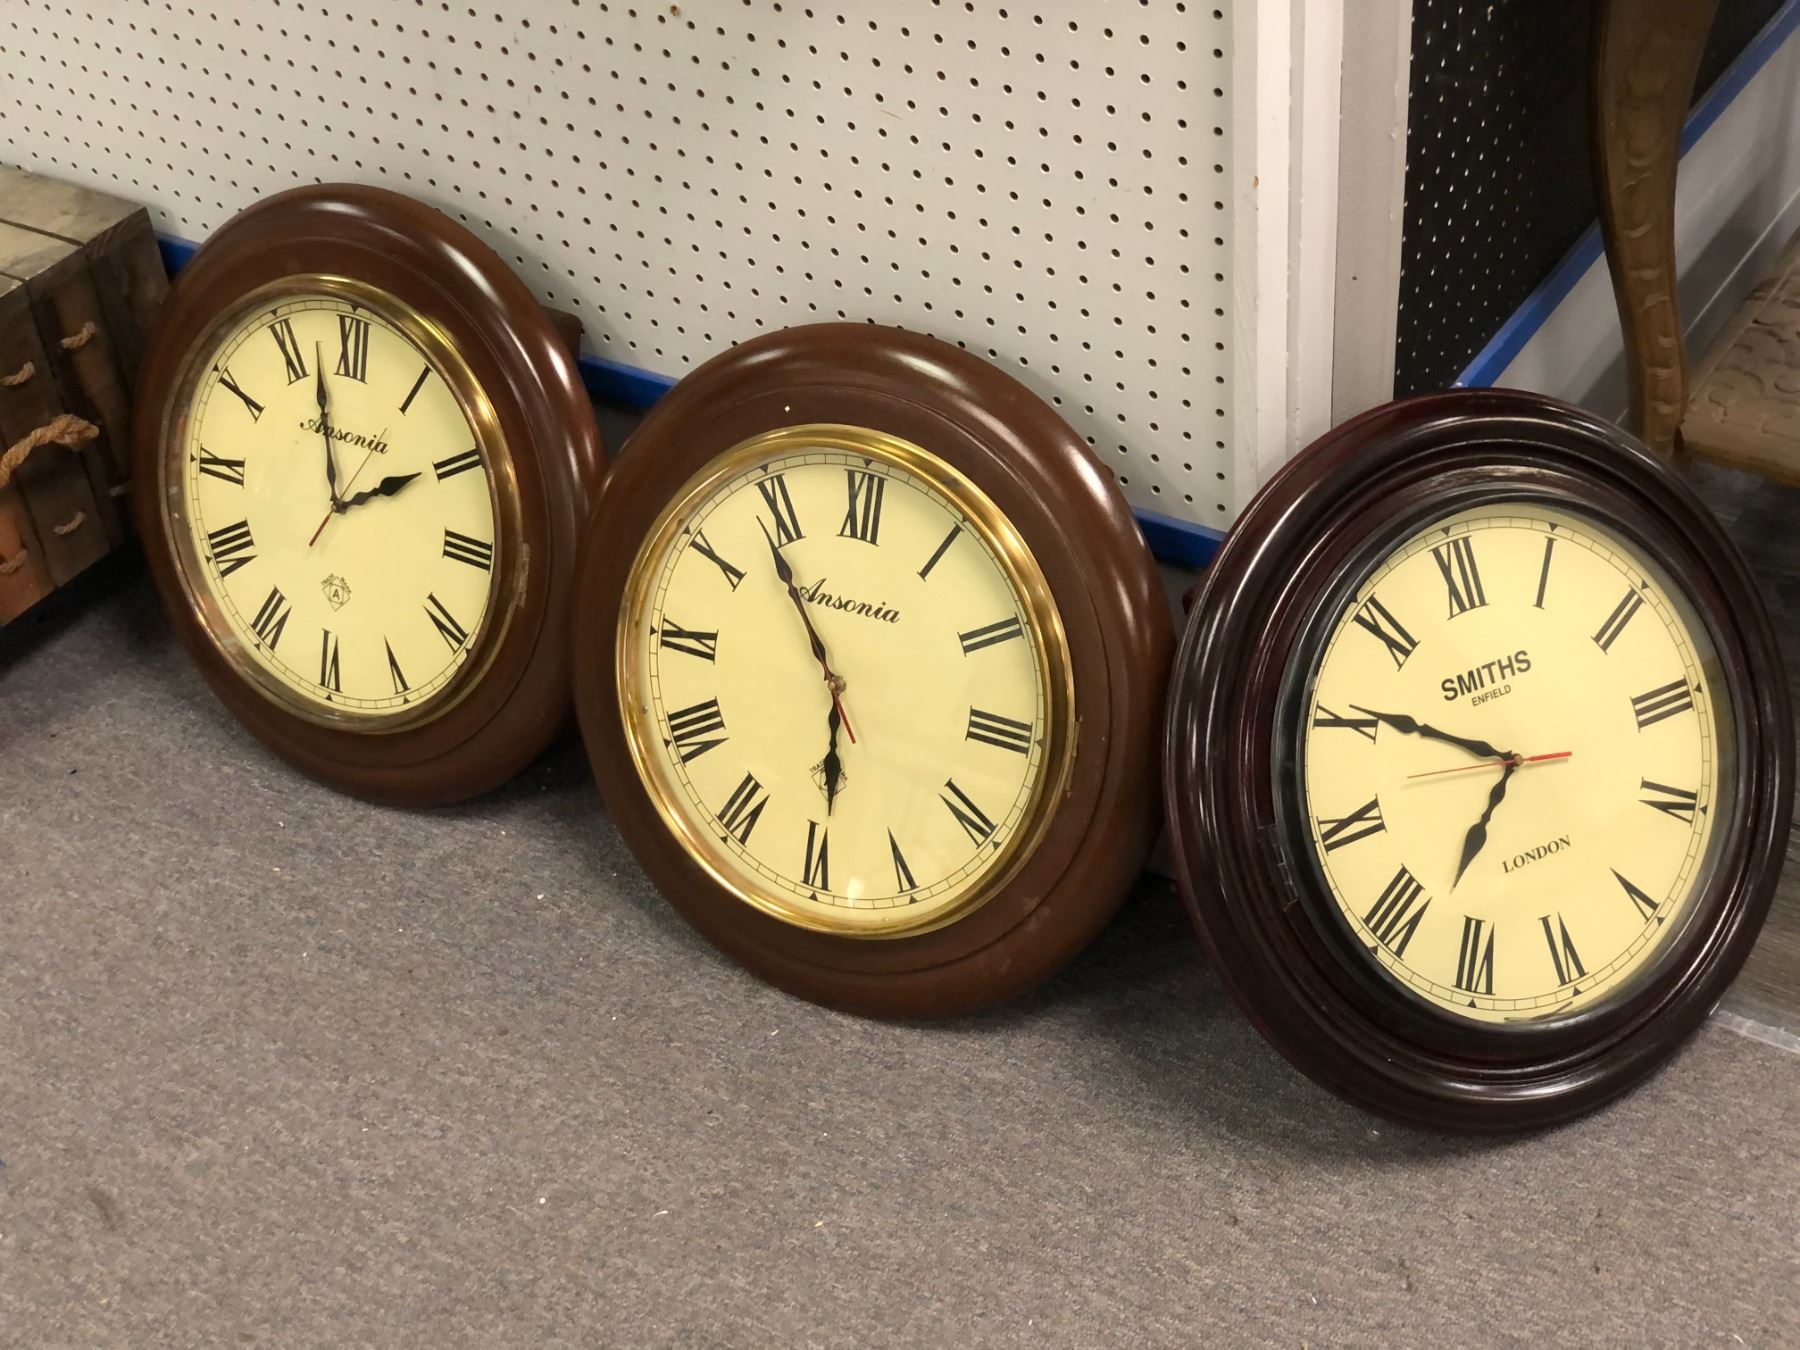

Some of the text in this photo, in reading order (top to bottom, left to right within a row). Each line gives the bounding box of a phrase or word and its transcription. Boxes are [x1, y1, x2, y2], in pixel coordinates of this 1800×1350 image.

[268, 318, 310, 386] XI
[334, 314, 369, 384] XII
[217, 366, 265, 423] X
[399, 362, 432, 416] I
[199, 443, 246, 488] IX
[433, 443, 484, 484] II
[754, 474, 806, 548] XI
[837, 469, 887, 546] XII
[208, 519, 258, 579] VIII
[442, 528, 493, 574] III
[688, 527, 747, 592] X
[917, 522, 964, 582] I
[1428, 535, 1489, 620] XII
[1533, 536, 1557, 609] I
[249, 585, 291, 652] VII
[424, 592, 469, 655] IV
[798, 577, 901, 624] Ansonia
[1590, 584, 1645, 655] II
[319, 628, 343, 693] VI
[660, 613, 719, 664] IX
[957, 611, 1025, 657] II
[1351, 592, 1420, 672] XI
[384, 635, 410, 695] V
[1440, 649, 1532, 702] SMITHS
[1471, 684, 1512, 707] ENFIELD
[667, 695, 730, 768] VIII
[965, 706, 1034, 758] III
[1313, 701, 1379, 744] X
[1630, 677, 1695, 732] III
[716, 771, 770, 848] VII
[938, 778, 999, 850] IV
[1317, 794, 1387, 855] IX
[1638, 776, 1698, 828] IV
[800, 819, 829, 892] VI
[887, 826, 920, 894] V
[1501, 834, 1572, 874] LONDON
[1361, 863, 1433, 961] VIII
[1609, 867, 1660, 924] V
[1452, 915, 1496, 995] VII
[1539, 911, 1588, 987] VI
